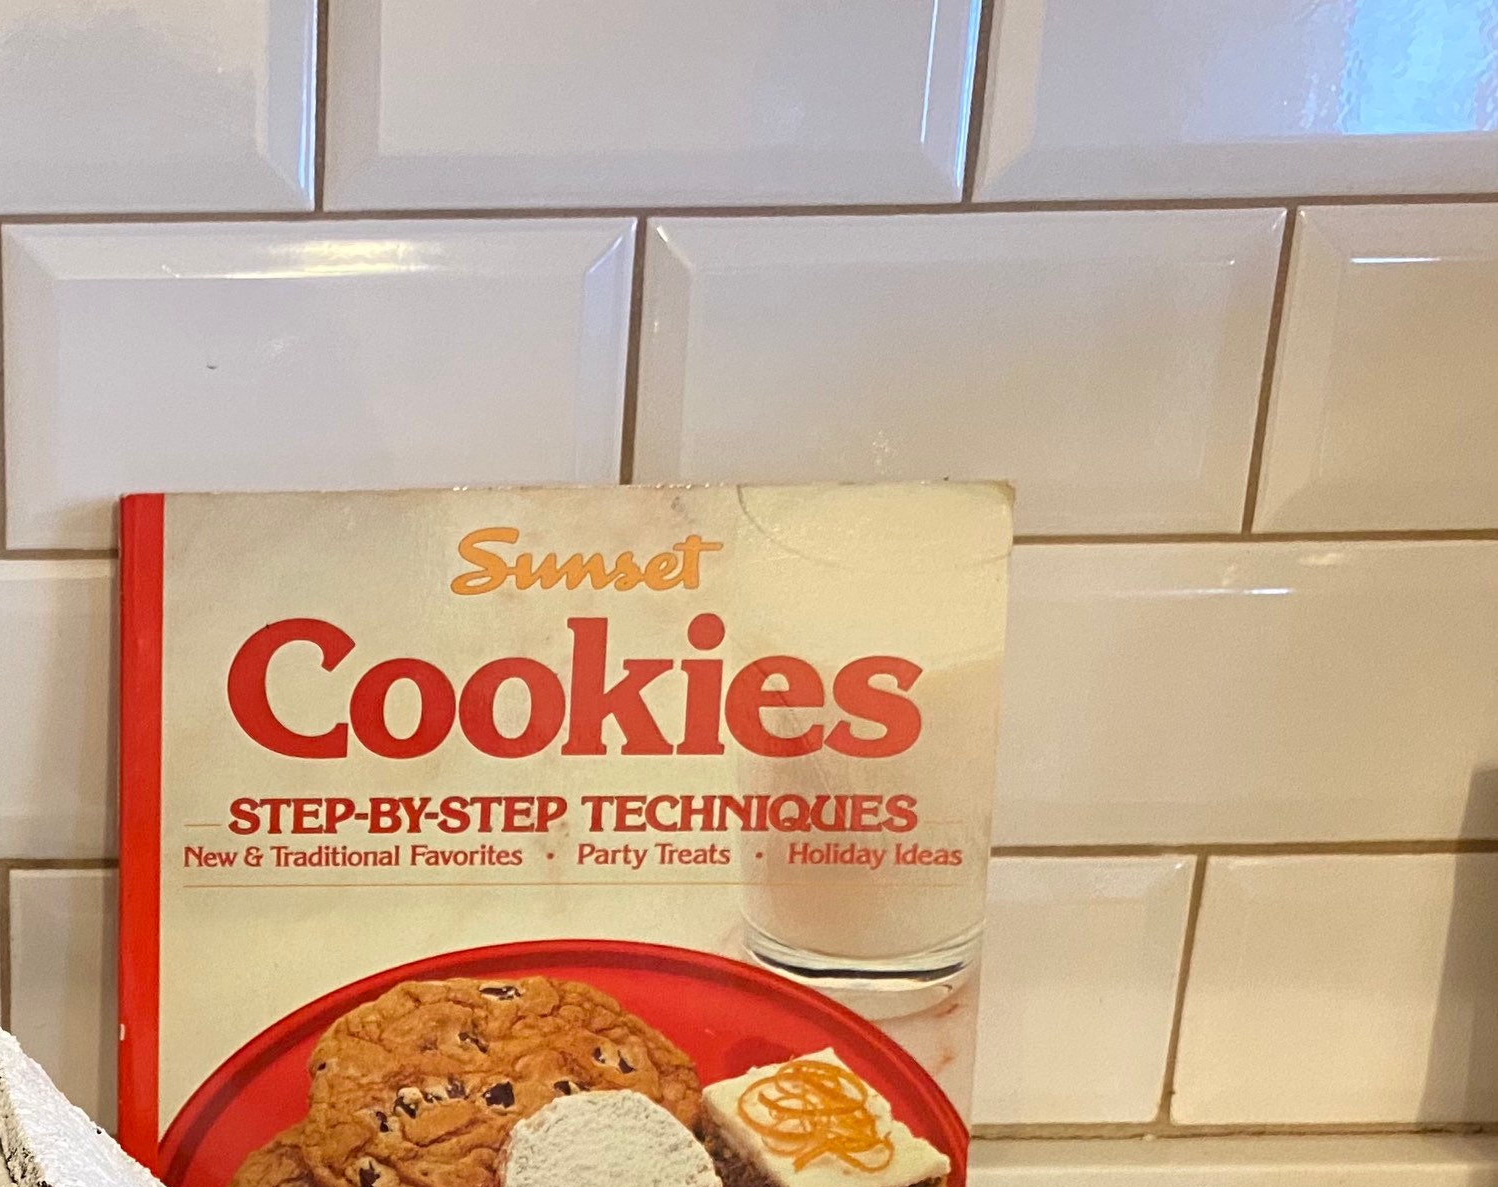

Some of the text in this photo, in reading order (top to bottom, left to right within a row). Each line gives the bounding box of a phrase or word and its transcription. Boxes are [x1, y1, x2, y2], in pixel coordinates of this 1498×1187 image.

[451, 527, 722, 596] Sunset
[227, 613, 922, 760] Cookies
[229, 794, 918, 835] STEP-BY-STEP TECHNIQUES
[183, 842, 963, 870] New & Traditional Favorites Party Treats Holiday Ideas
